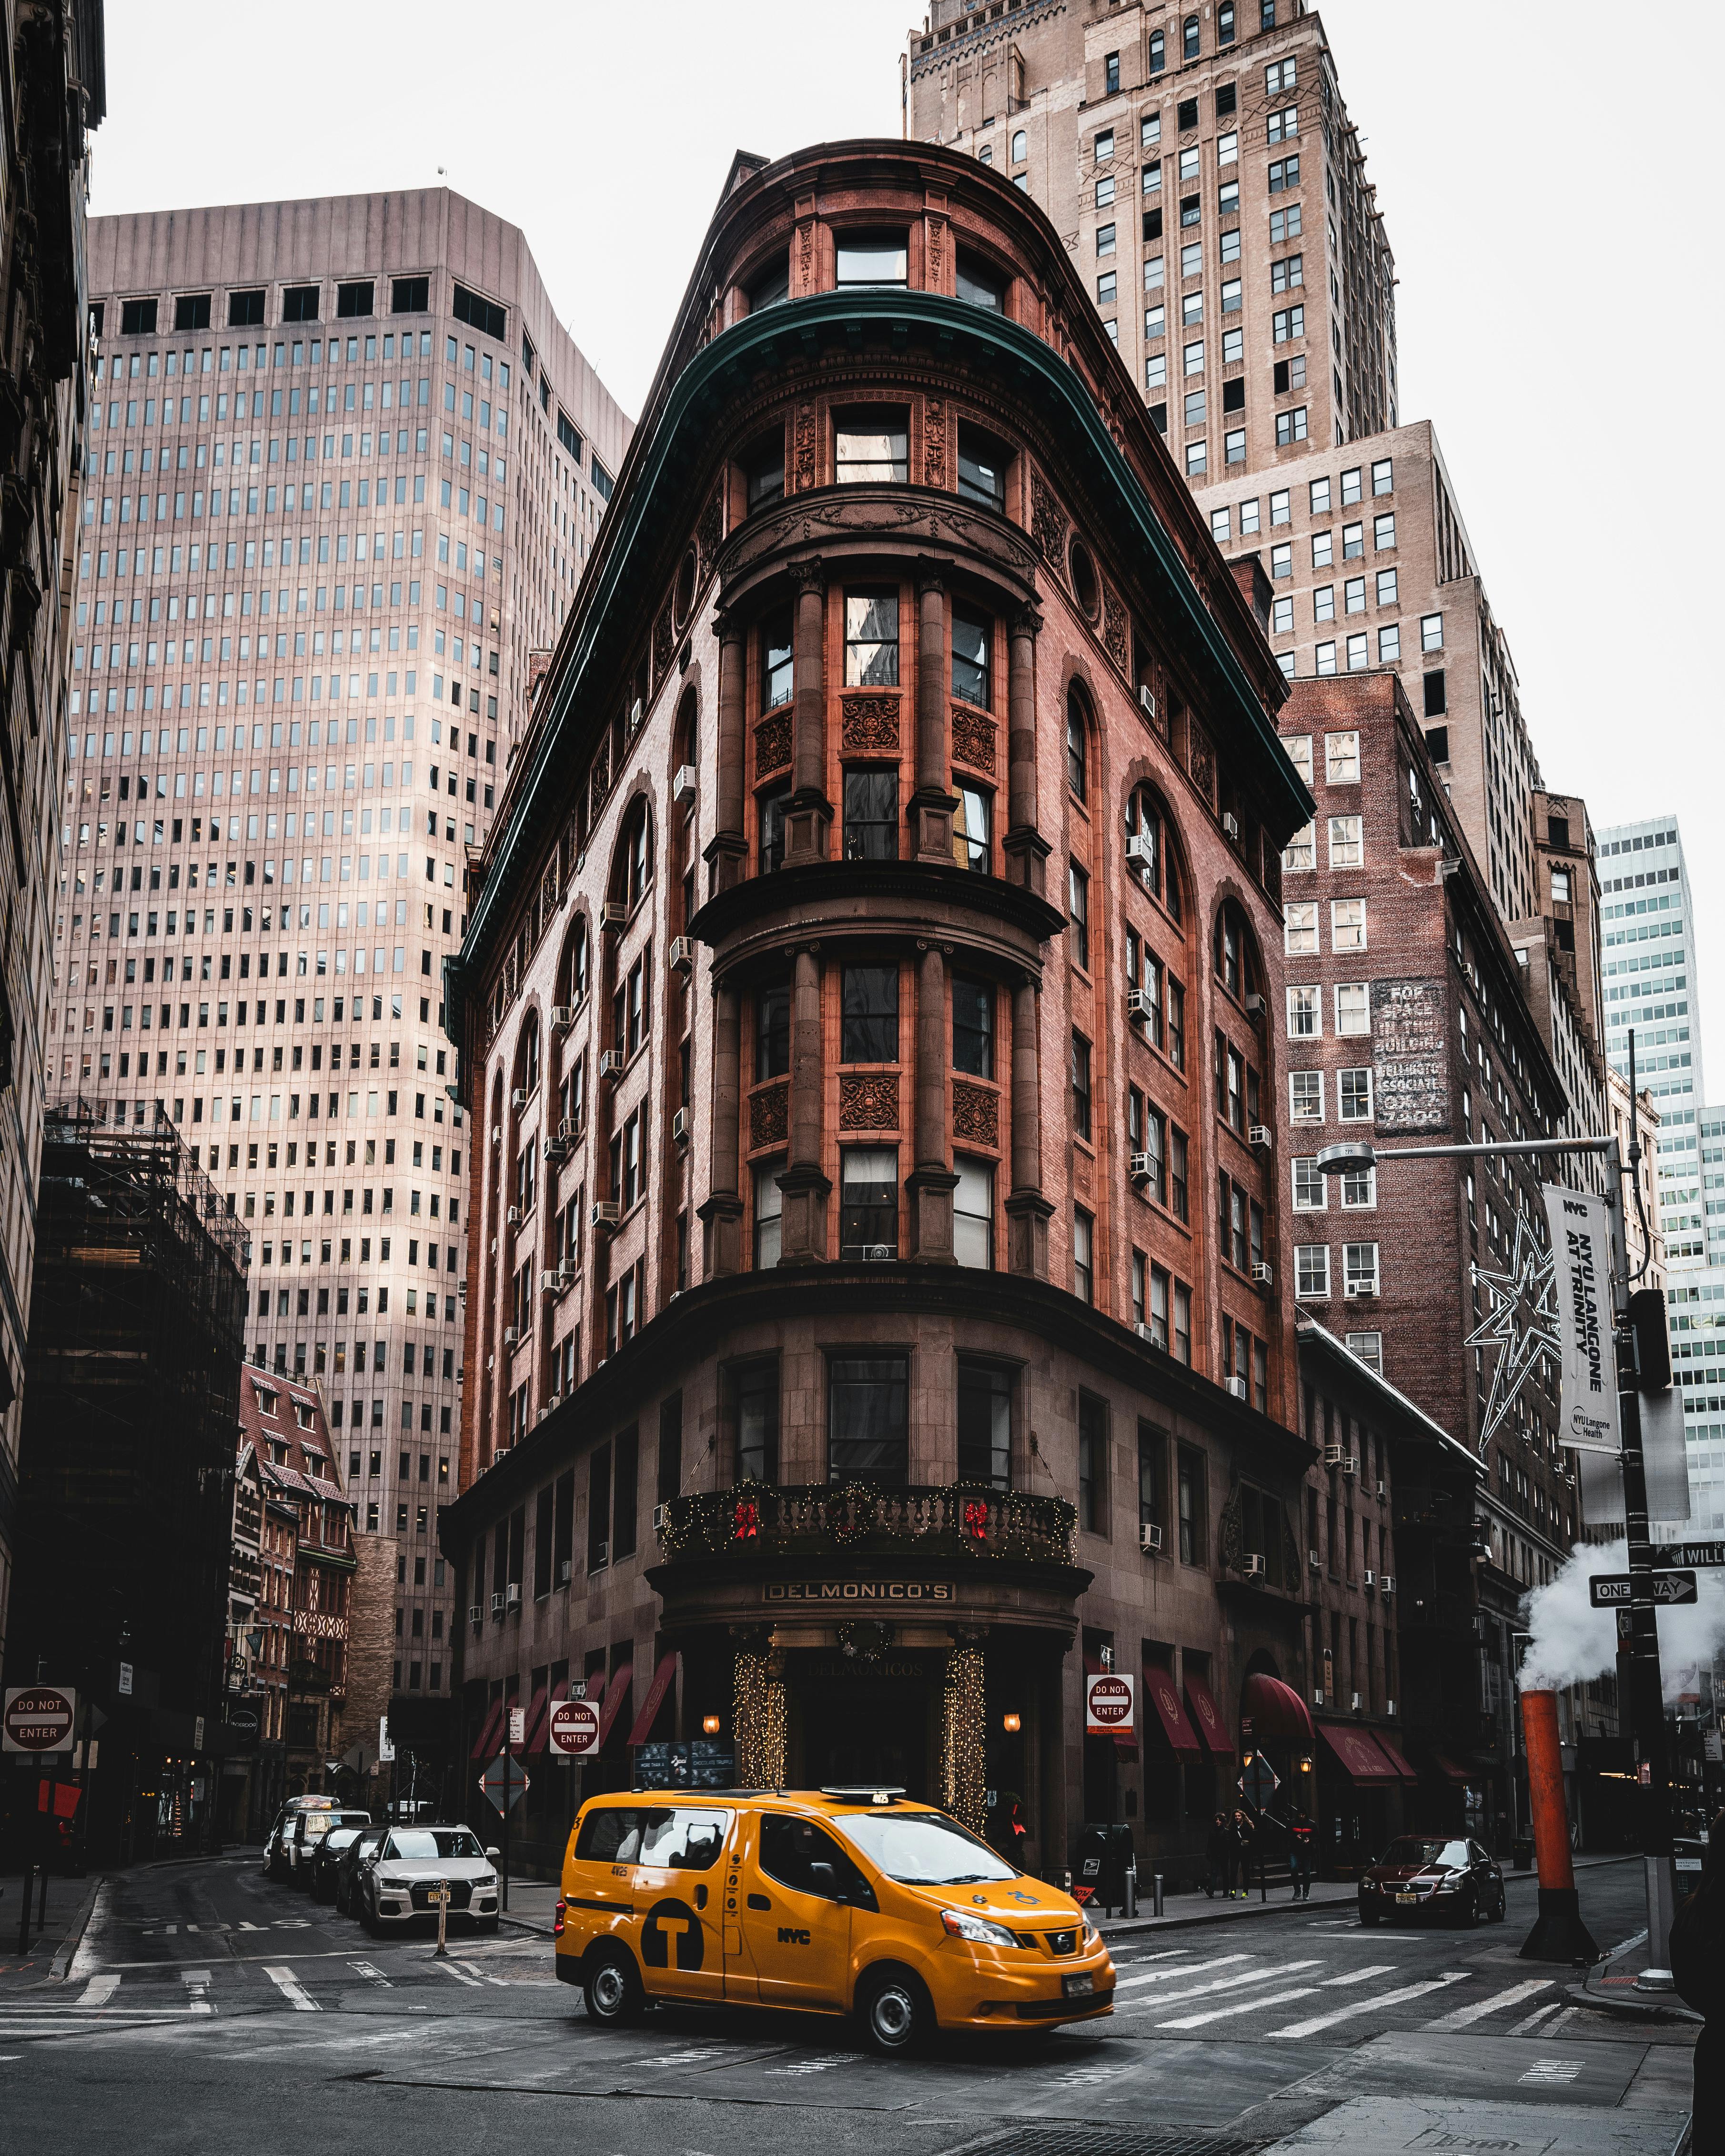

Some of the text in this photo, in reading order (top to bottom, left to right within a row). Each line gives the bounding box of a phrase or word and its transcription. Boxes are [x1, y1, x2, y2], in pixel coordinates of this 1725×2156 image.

[1563, 1199, 1588, 1218] NYC
[1566, 1229, 1588, 1356] AT TRINITY
[1578, 1233, 1601, 1393] NYU LANGONE
[1573, 1413, 1610, 1430] NYU Langone
[1583, 1427, 1603, 1439] Health
[769, 1583, 948, 1599] DELMONICO'S
[1599, 1583, 1630, 1597] ONE
[19, 1701, 61, 1710] DO NOT
[558, 1712, 591, 1721] DO NOT
[20, 1728, 57, 1738] ENTER
[561, 1735, 587, 1743] ENTER
[142, 1919, 313, 1934] STOP
[656, 1916, 689, 1970] T
[777, 1927, 811, 1945] NYC
